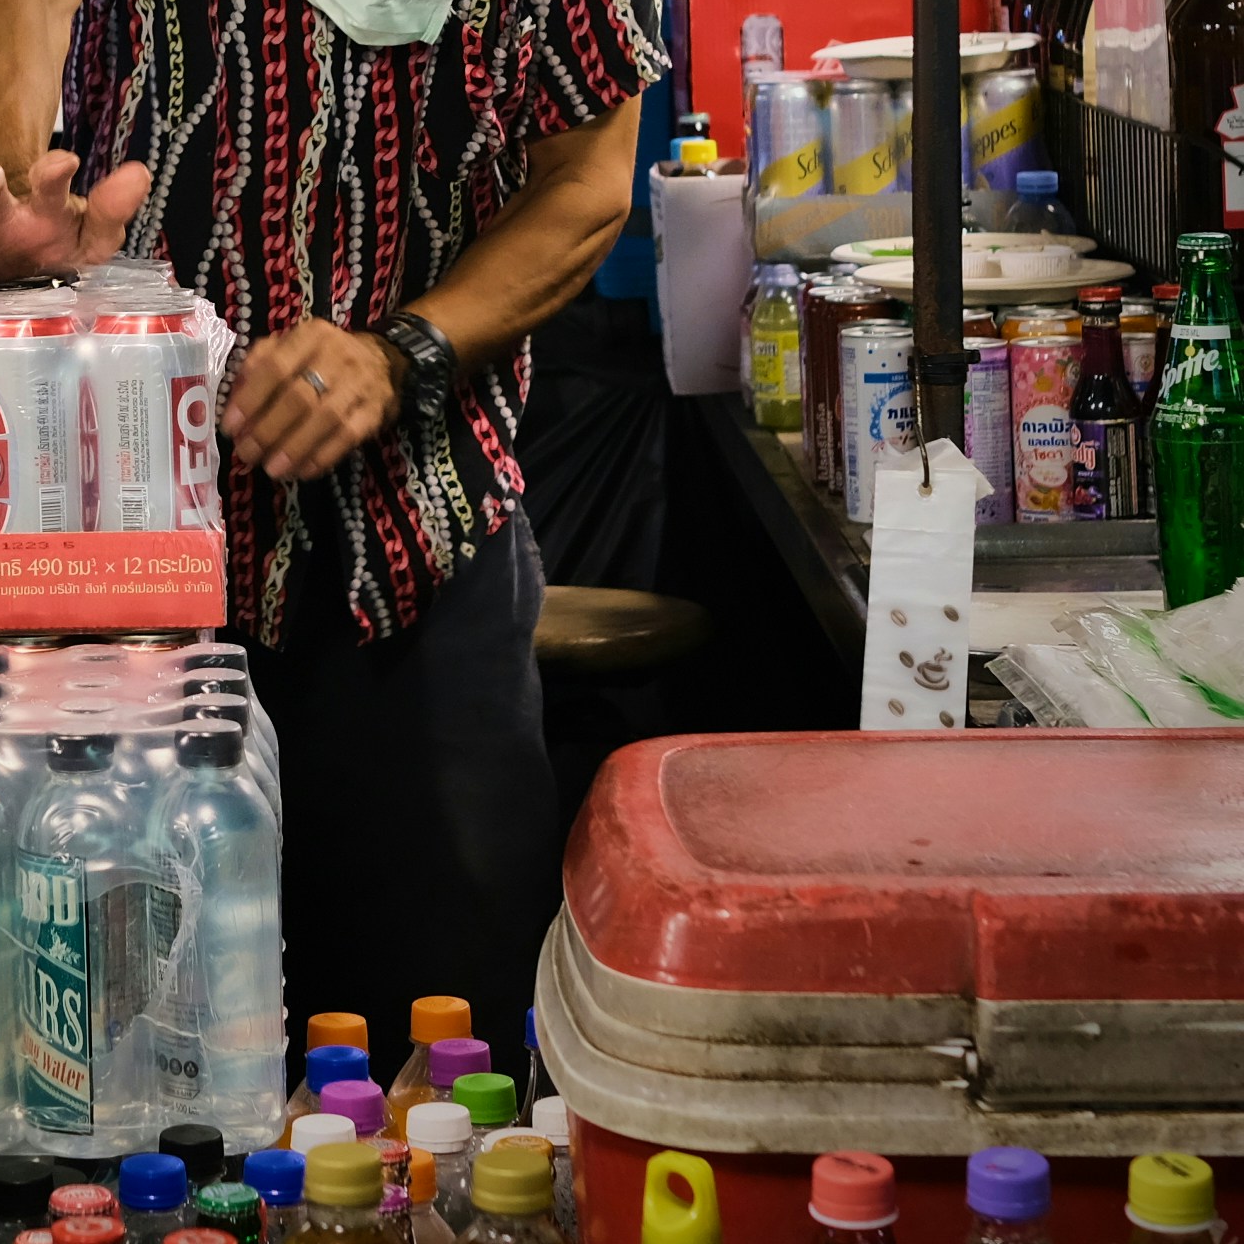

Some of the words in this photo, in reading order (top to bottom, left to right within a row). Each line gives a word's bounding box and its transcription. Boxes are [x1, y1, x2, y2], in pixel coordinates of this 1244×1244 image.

[1158, 348, 1223, 399] Sprite
[27, 558, 63, 577] 490
[124, 557, 143, 576] 12
[149, 553, 213, 575] กระป๋อง
[49, 581, 80, 595] บริษัท
[184, 580, 213, 594] จำกัด
[42, 1051, 85, 1092] water
